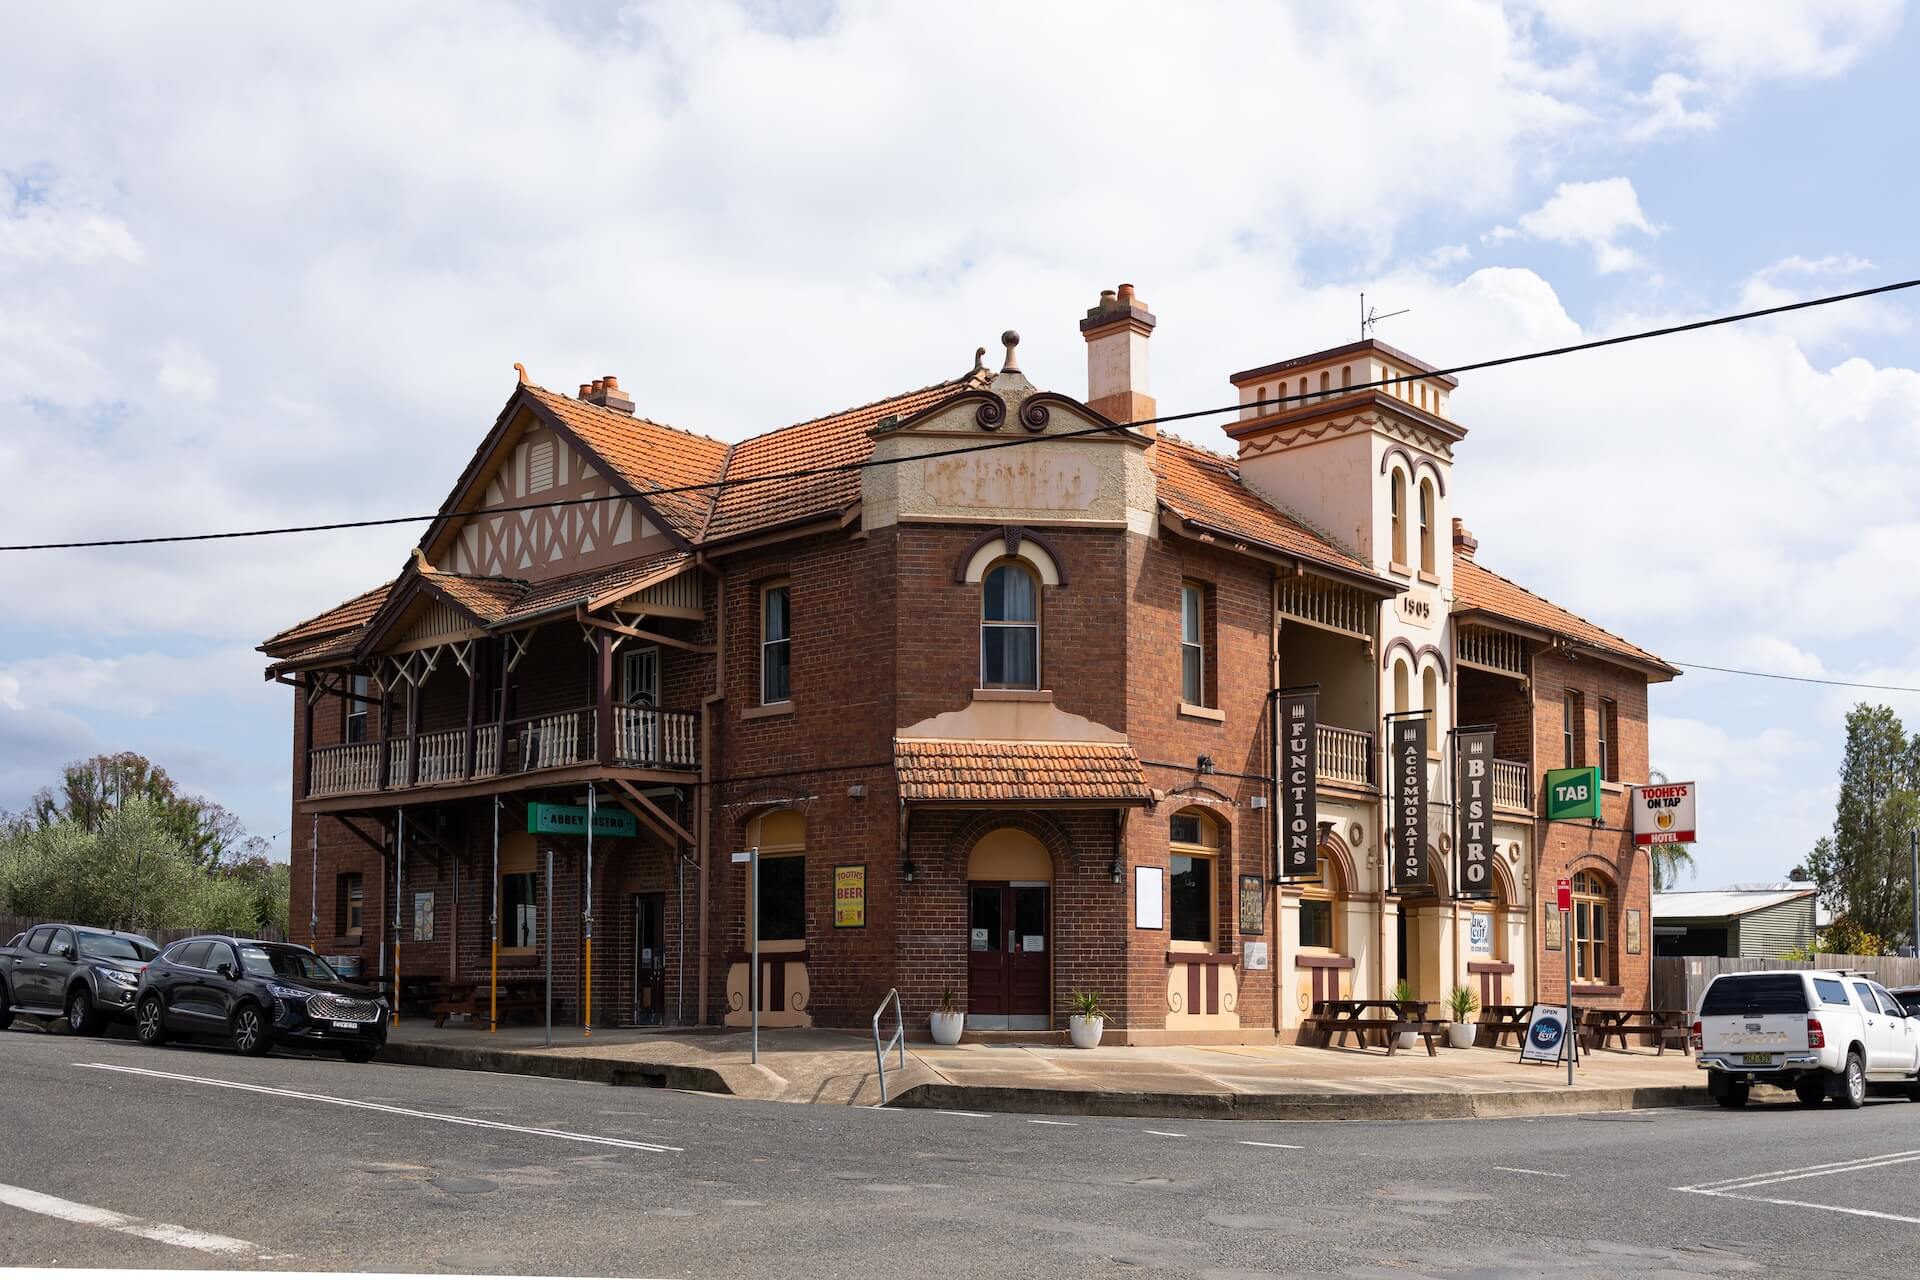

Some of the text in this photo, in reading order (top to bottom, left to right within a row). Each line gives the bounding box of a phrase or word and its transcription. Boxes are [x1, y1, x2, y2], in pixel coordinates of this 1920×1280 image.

[1404, 597, 1430, 619] 1905
[1290, 723, 1308, 865] FUNCTIONS
[1556, 785, 1588, 802] TAB
[1641, 786, 1688, 799] TOOHEYS
[1647, 797, 1681, 809] ON TAP
[1403, 746, 1420, 878] ACCOMMODATION
[550, 813, 584, 825] ABBEY
[1467, 759, 1486, 883] BISTRO
[1651, 832, 1679, 843] HOTEL
[837, 887, 863, 899] BEER
[1240, 902, 1263, 915] HOUR
